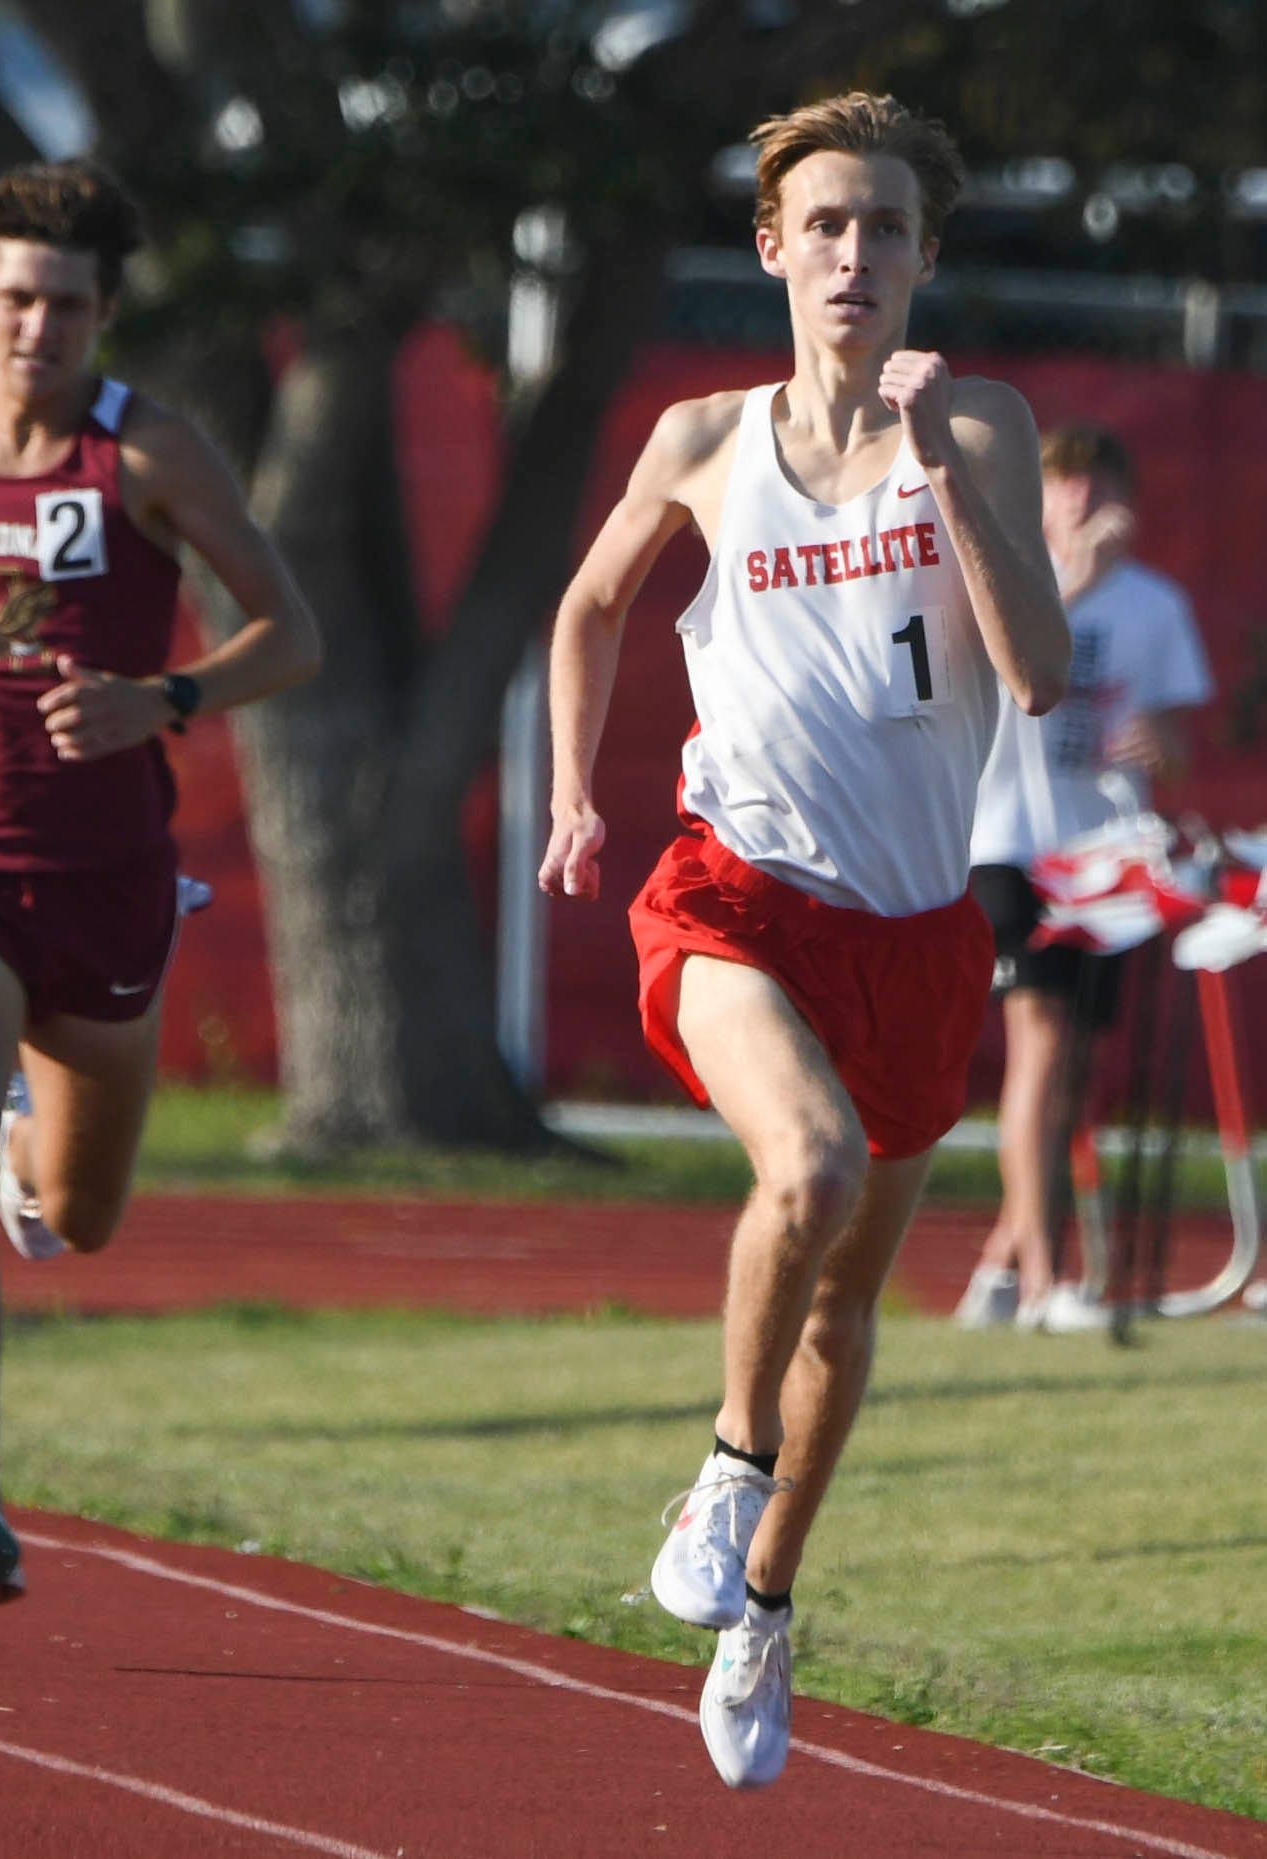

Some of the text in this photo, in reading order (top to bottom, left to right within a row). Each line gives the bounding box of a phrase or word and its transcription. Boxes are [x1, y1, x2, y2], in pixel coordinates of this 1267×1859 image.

[48, 500, 93, 572] 2
[747, 522, 940, 593] SATELLITE
[891, 614, 934, 701] 1
